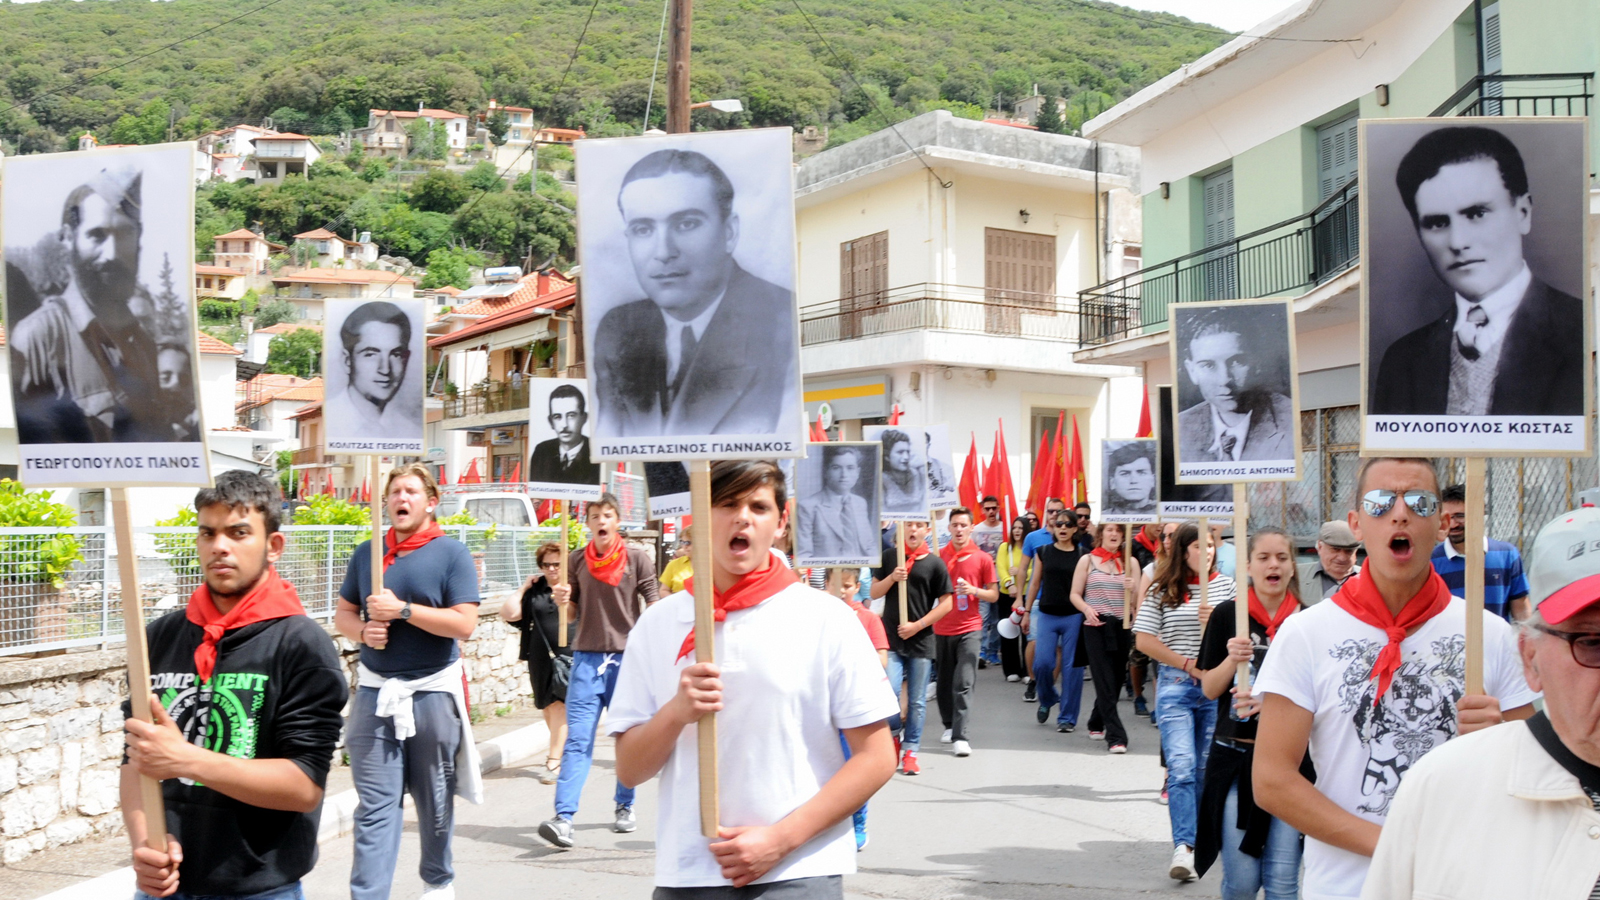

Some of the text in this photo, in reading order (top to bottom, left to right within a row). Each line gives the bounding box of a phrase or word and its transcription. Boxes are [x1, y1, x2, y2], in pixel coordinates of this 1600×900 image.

[1375, 422, 1574, 434] ΜΟΥΛΟΠΟΥΛΟΣ ΚΩΣΤΑΣ
[601, 442, 792, 455] ΠΑΠΑΣΤΑΣΙΝΟΣ ΓΙΑΝΝΑΚΟΣ
[26, 457, 200, 469] ΓΕΩΡΓΟΠΟΥΛΟΣ ΠΑΝΟΣ
[1180, 466, 1296, 476] ΔΗΜΟΠΟΥΛΟΣ ΑΝΤΩΝΗΣ
[653, 506, 684, 516] ΜΑΝΤΑ
